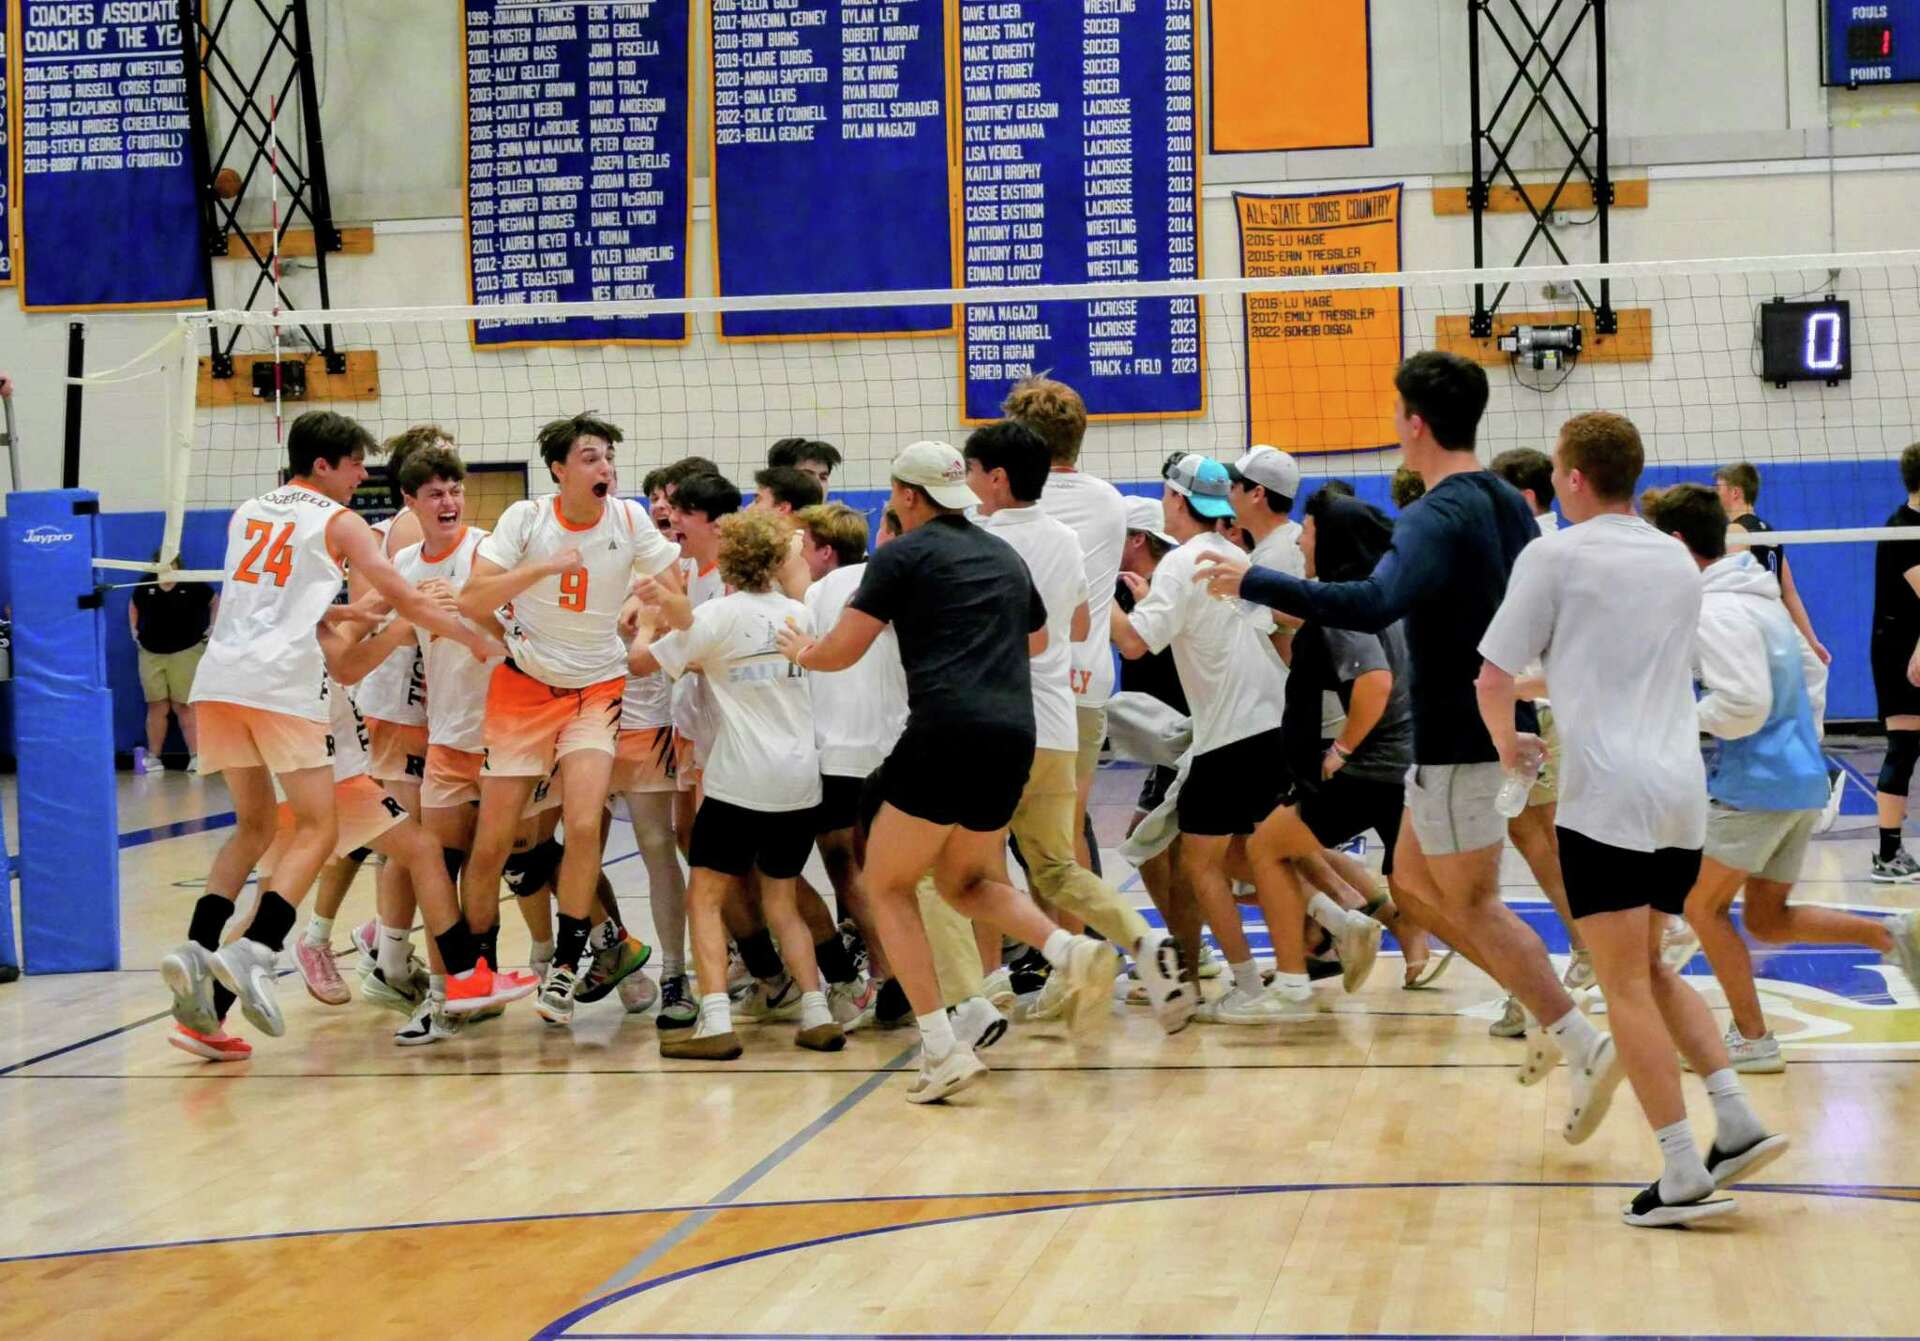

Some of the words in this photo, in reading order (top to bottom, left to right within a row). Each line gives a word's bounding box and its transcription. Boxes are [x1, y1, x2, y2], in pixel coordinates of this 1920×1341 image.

[30, 4, 94, 27] COACHES
[537, 7, 575, 23] FRANCIS
[588, 6, 609, 21] ERIC
[963, 6, 985, 21] DAVE
[988, 4, 1020, 19] OLIGER
[1084, 0, 1136, 14] WRESTLING
[1852, 5, 1887, 20] FOULS
[790, 11, 827, 27] CERNEY
[842, 8, 874, 24] DYLAN
[880, 8, 899, 23] LEW
[1166, 15, 1191, 31] 2004
[842, 27, 879, 43] ROBERT
[883, 25, 919, 41] MURRAY
[963, 25, 1000, 41] MARCUS
[1004, 22, 1035, 38] TRACY
[1083, 18, 1119, 34] SOCCER
[25, 29, 79, 52] COACH
[87, 28, 107, 49] OF
[116, 27, 147, 48] THE
[768, 31, 799, 47] BURNS
[1083, 38, 1119, 55] SOCCER
[1165, 35, 1191, 51] 2005
[1881, 28, 1892, 56] 1
[533, 45, 558, 61] BASS
[588, 43, 613, 58] JOHN
[842, 46, 867, 62] SHEA
[870, 45, 906, 61] TALBOT
[964, 46, 989, 61] MARC
[992, 43, 1035, 59] DOHERTY
[126, 59, 184, 76] (WRESTLING)
[589, 61, 614, 77] DAVID
[1083, 58, 1119, 75] SOCCER
[1165, 55, 1191, 71] 2005
[842, 66, 864, 82] RICK
[868, 65, 898, 80] IRVING
[964, 66, 994, 82] CASEY
[1850, 65, 1892, 81] POINTS
[75, 82, 115, 97] RUSSELL
[118, 80, 150, 95] (CROSS
[589, 80, 613, 96] RYAN
[618, 79, 649, 95] TRACY
[842, 85, 867, 100] RYAN
[869, 83, 899, 99] RUDDY
[965, 85, 992, 102] TANIA
[994, 82, 1041, 100] DOMINGOS
[1083, 78, 1119, 95] SOCCER
[769, 88, 796, 103] LEWIS
[590, 99, 614, 115] DAVID
[619, 98, 666, 113] ANDERSON
[842, 103, 887, 119] MITCHELL
[890, 100, 939, 117] SCHRADER
[965, 104, 1014, 122] COURTNEY
[1016, 102, 1059, 119] GLEASON
[1083, 98, 1132, 116] LACROSSE
[590, 118, 625, 134] MARCUS
[629, 117, 658, 132] TRACY
[842, 123, 874, 139] DYLAN
[877, 121, 916, 138] MAGAZU
[1083, 119, 1132, 137] LACROSSE
[1166, 116, 1191, 132] 2009
[779, 125, 814, 141] GERACE
[965, 125, 991, 141] KYLE
[88, 136, 123, 151] GEORGE
[126, 133, 184, 150] (FOOTBALL)
[591, 137, 619, 152] PETER
[1083, 138, 1133, 156] LACROSSE
[1167, 136, 1192, 152] 2010
[81, 154, 123, 170] PATTISON
[126, 151, 183, 168] (FOOTBALL)
[590, 155, 624, 170] JOSEPH
[965, 146, 986, 162] LISA
[965, 165, 1001, 182] KAITLIN
[1004, 163, 1042, 180] BROPHY
[1084, 158, 1133, 176] LACROSSE
[1167, 156, 1192, 172] 2011
[965, 185, 998, 202] CASSIE
[1000, 183, 1044, 200] EKSTROM
[1084, 178, 1133, 196] LACROSSE
[1167, 176, 1193, 192] 2013
[591, 193, 618, 208] KEITH
[1085, 198, 1133, 216] LACROSSE
[1168, 196, 1193, 213] 2014
[627, 210, 656, 225] LYNCH
[966, 205, 998, 222] CASSIE
[1000, 203, 1045, 220] EKSTROM
[1246, 202, 1301, 225] ALL-STATE
[1308, 200, 1341, 224] CROSS
[1347, 194, 1391, 220] COUNTRY
[967, 225, 1010, 242] ANTHONY
[1013, 223, 1042, 239] FALBO
[1086, 218, 1137, 236] WRESTLING
[1168, 216, 1193, 233] 2014
[1087, 239, 1138, 257] WRESTLING
[1168, 237, 1194, 253] 2015
[1297, 233, 1326, 246] HAGE
[540, 252, 567, 268] LYNCH
[591, 249, 621, 265] KYLER
[967, 246, 1010, 262] ANTHONY
[1013, 243, 1043, 260] FALBO
[1308, 247, 1361, 260] TRESSLER
[591, 266, 611, 282] DAN
[614, 265, 648, 281] HEBERT
[967, 265, 1004, 282] EDWARD
[1007, 263, 1042, 280] LOVELY
[1087, 259, 1139, 277] WRESTLING
[1169, 257, 1194, 273] 2015
[1321, 261, 1376, 275] MAWDSLEY
[592, 286, 611, 301] WES
[1304, 296, 1333, 308] HAGE
[968, 306, 995, 322] EMMA
[998, 304, 1038, 321] MAGAZU
[1088, 300, 1138, 317] LACROSSE
[1170, 298, 1196, 314] 2021
[1320, 308, 1375, 321] TRESSLER
[968, 325, 1006, 341] SUMMER
[1008, 324, 1051, 340] HARRELL
[1088, 320, 1137, 338] LACROSSE
[1170, 320, 1197, 334] 2023
[1323, 324, 1353, 335] DISSA
[1089, 340, 1133, 357] SWIMMING
[1170, 339, 1197, 354] 2023
[1807, 311, 1841, 369] 0
[968, 345, 999, 361] PETER
[1002, 344, 1035, 360] HORAN
[1090, 360, 1122, 376] TRACK
[1124, 363, 1131, 375] &
[1134, 359, 1162, 374] FIELD
[1172, 358, 1197, 374] 2023
[22, 528, 74, 545] Jaypro
[233, 518, 297, 587] 24
[558, 566, 588, 613] 9
